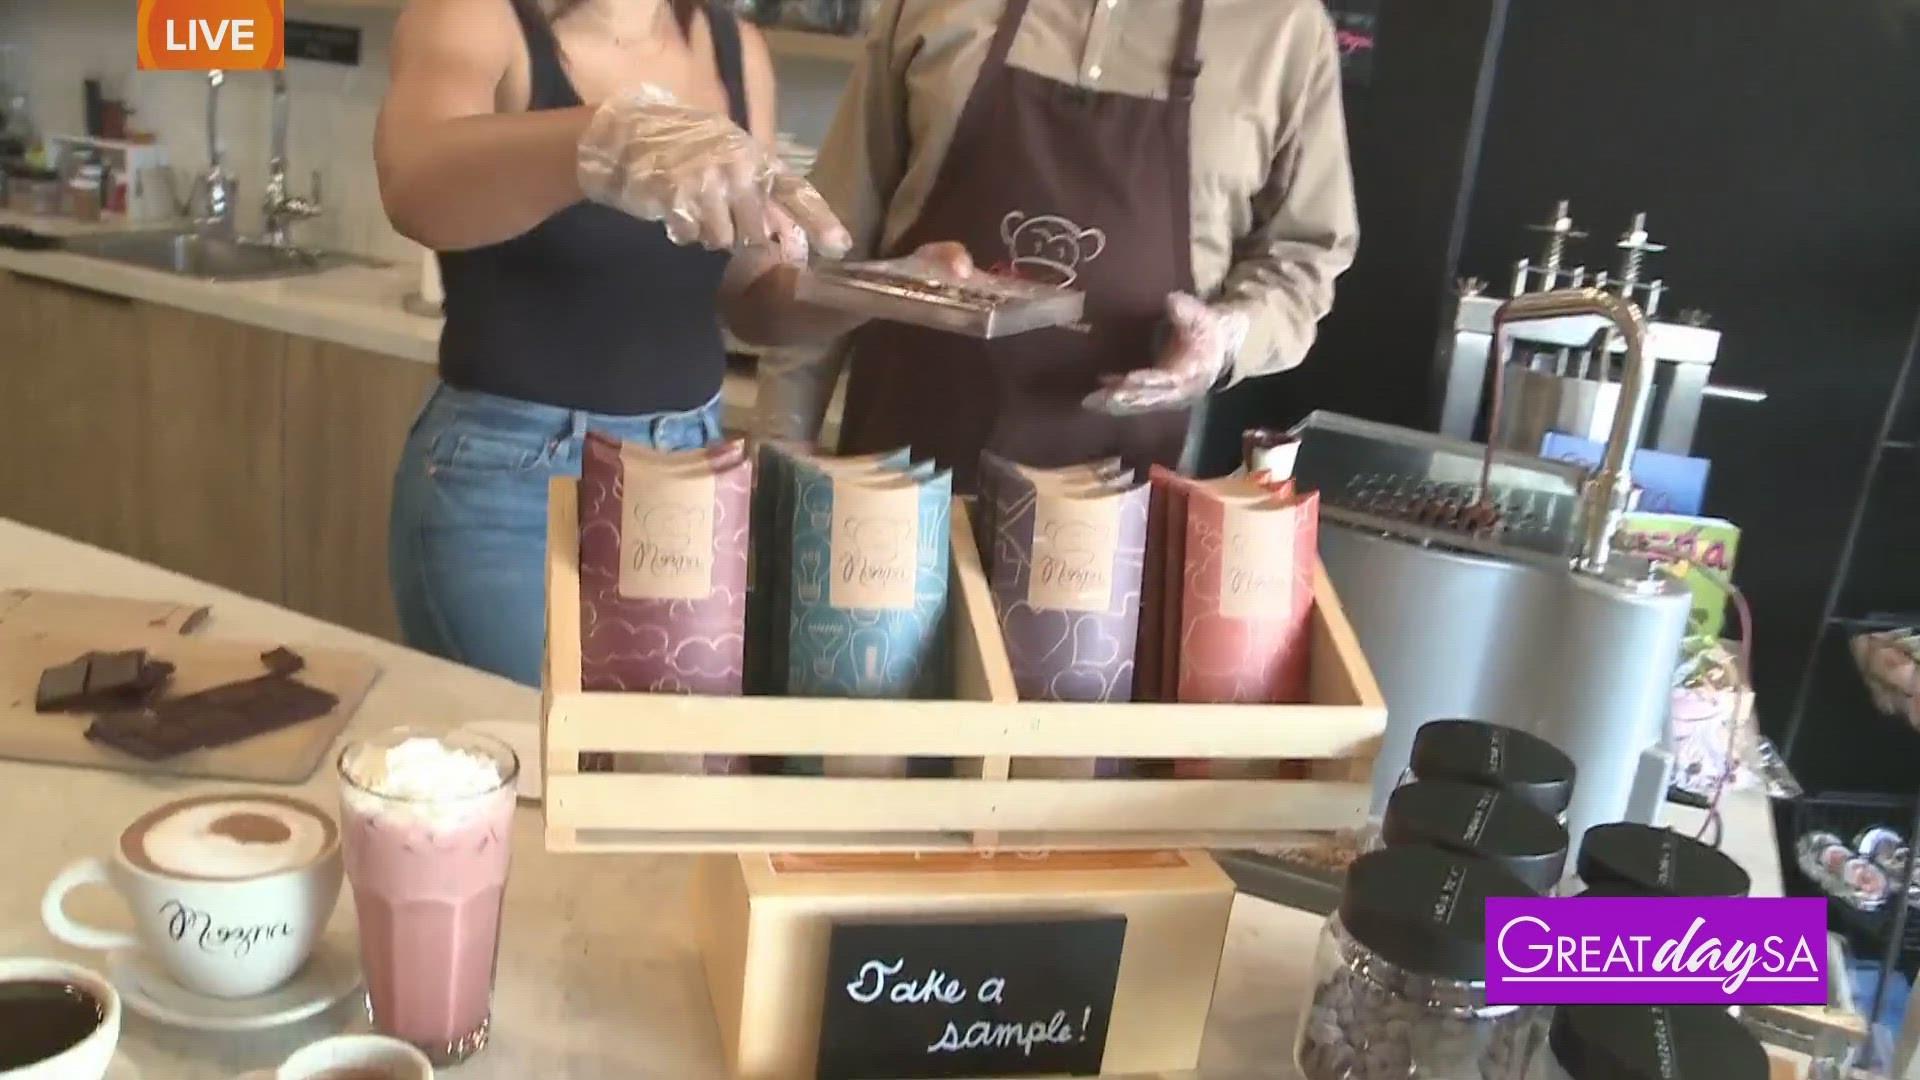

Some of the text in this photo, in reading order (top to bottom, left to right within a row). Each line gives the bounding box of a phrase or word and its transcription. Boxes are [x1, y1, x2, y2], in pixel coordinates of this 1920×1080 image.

[846, 957, 1006, 1004] Take a
[926, 1004, 1092, 1057] sample!
